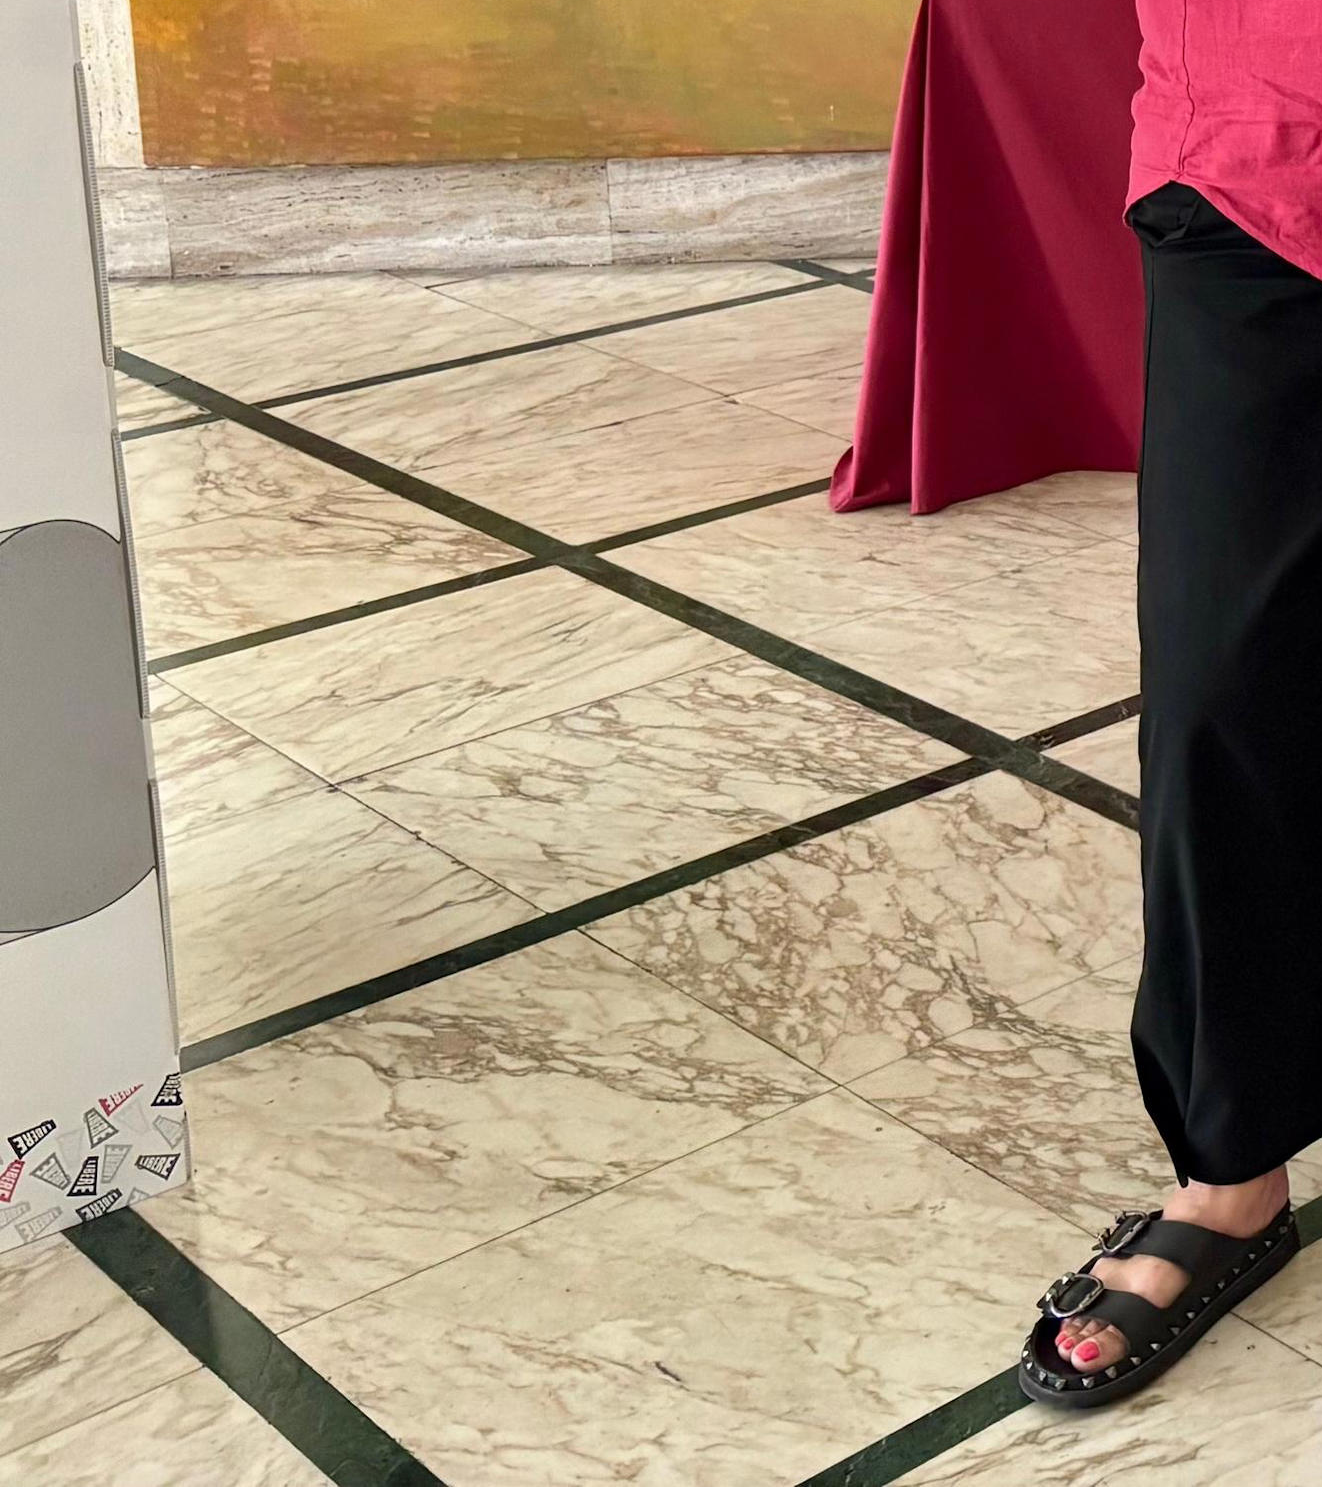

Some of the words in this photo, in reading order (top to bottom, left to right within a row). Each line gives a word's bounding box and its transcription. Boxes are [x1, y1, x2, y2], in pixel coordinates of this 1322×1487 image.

[12, 1122, 53, 1156] LIBERE
[72, 1158, 98, 1195] LIBERE
[139, 1155, 176, 1178] LIBERE
